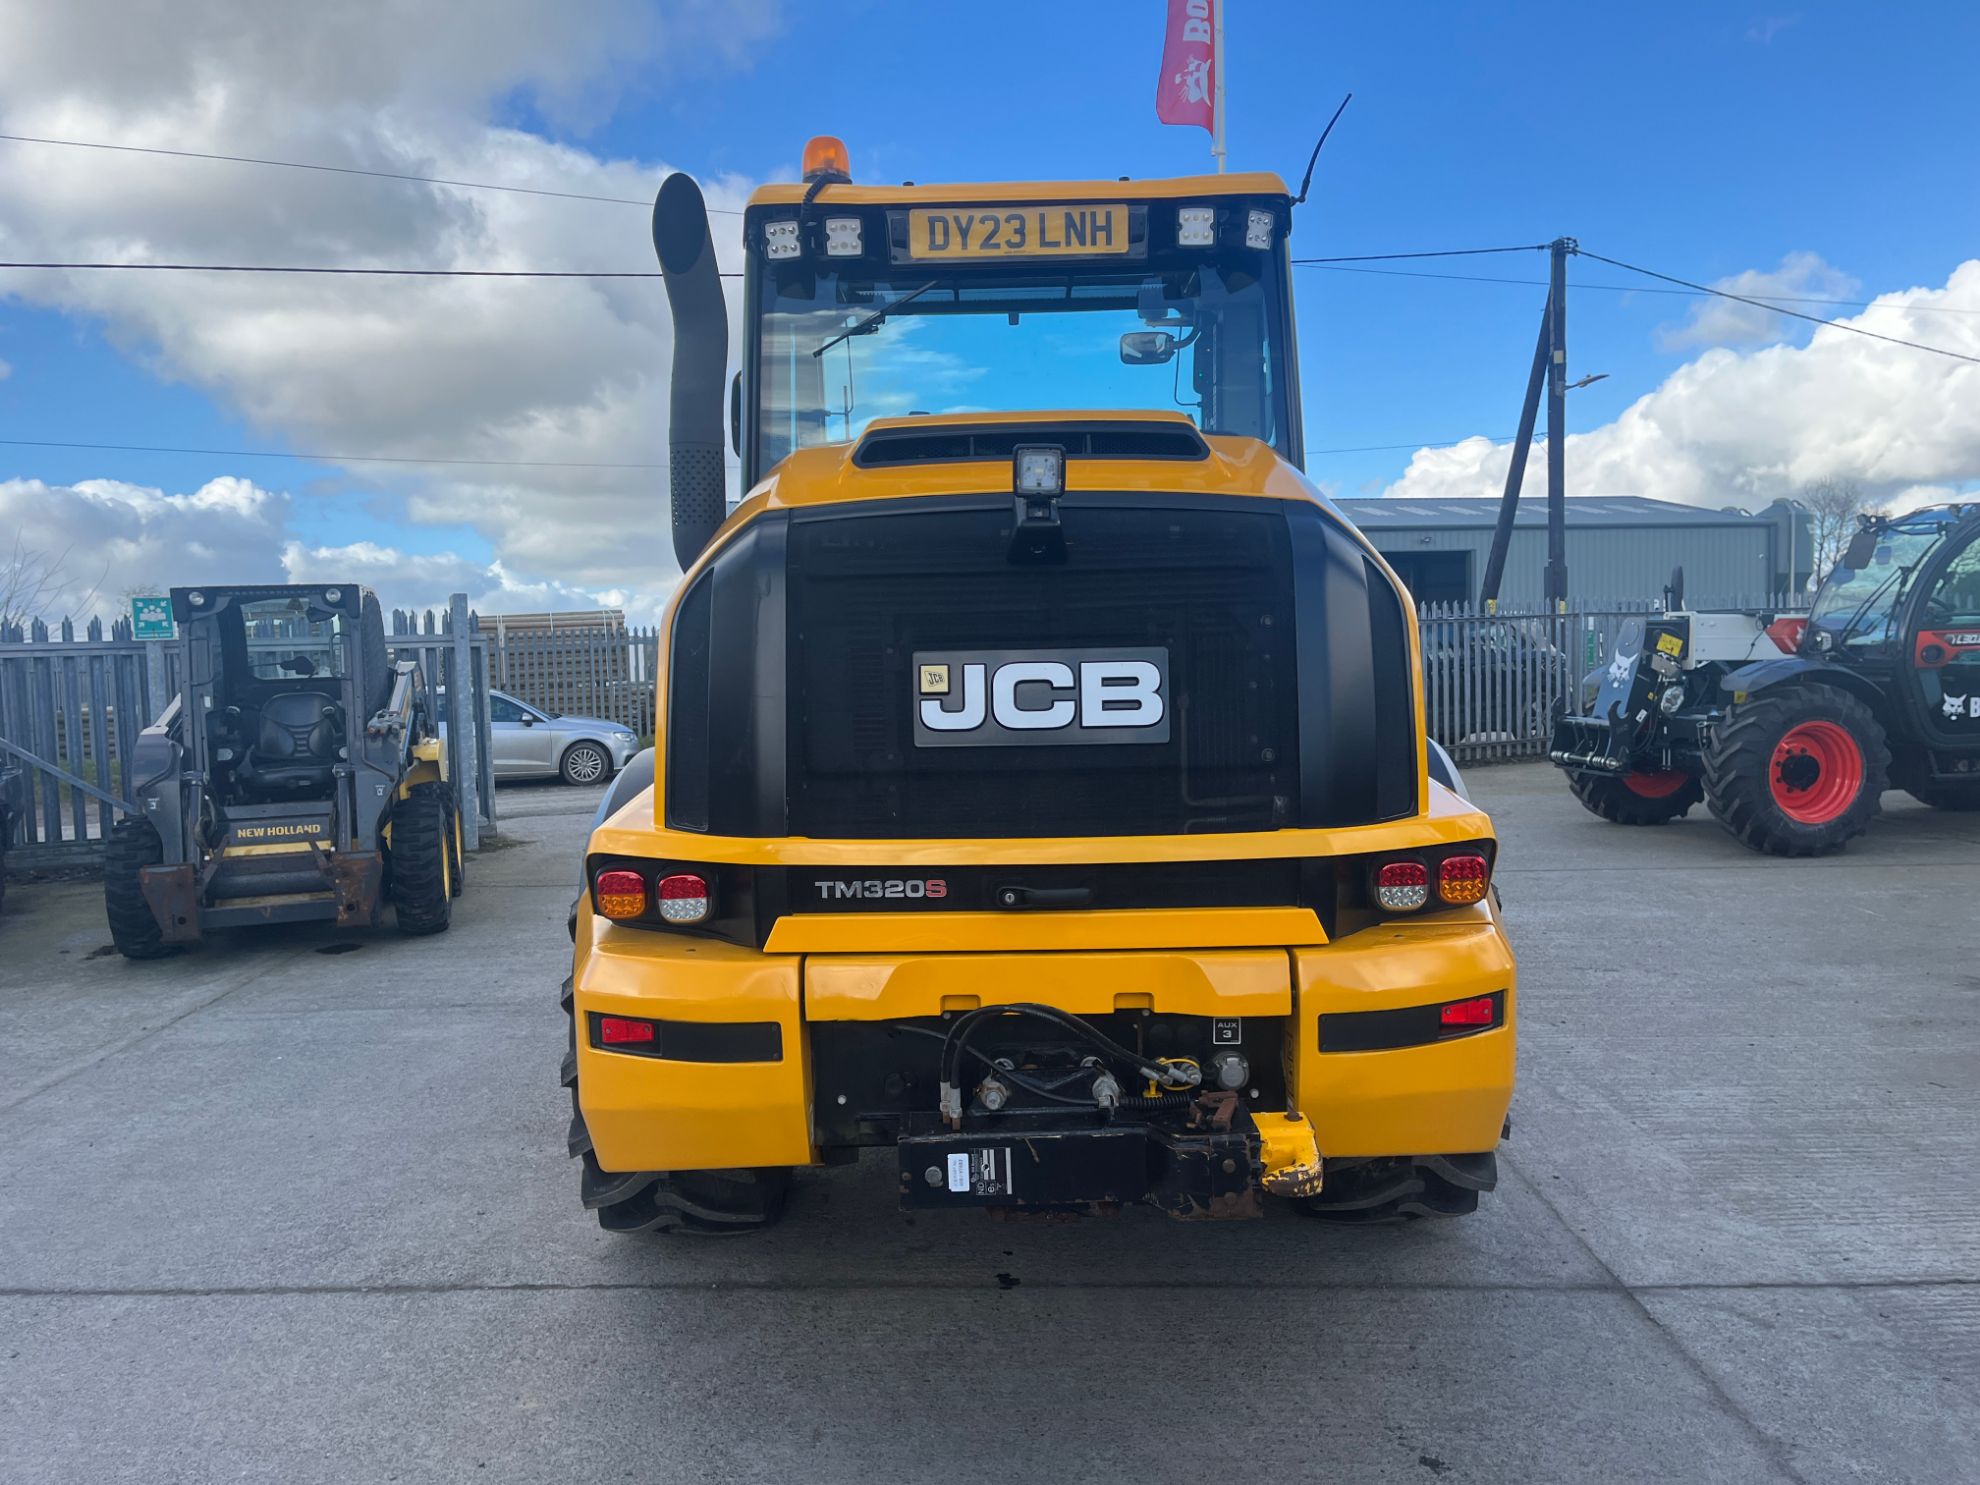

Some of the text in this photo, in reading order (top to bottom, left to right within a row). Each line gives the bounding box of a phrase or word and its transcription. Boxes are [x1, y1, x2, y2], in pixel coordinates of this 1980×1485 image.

[928, 211, 1112, 250] DY23 LNH
[928, 672, 944, 685] JCB
[919, 661, 1165, 730] JCB
[237, 824, 321, 838] NEW HOLLAND
[814, 879, 948, 899] TM320S
[1222, 1029, 1232, 1039] 3
